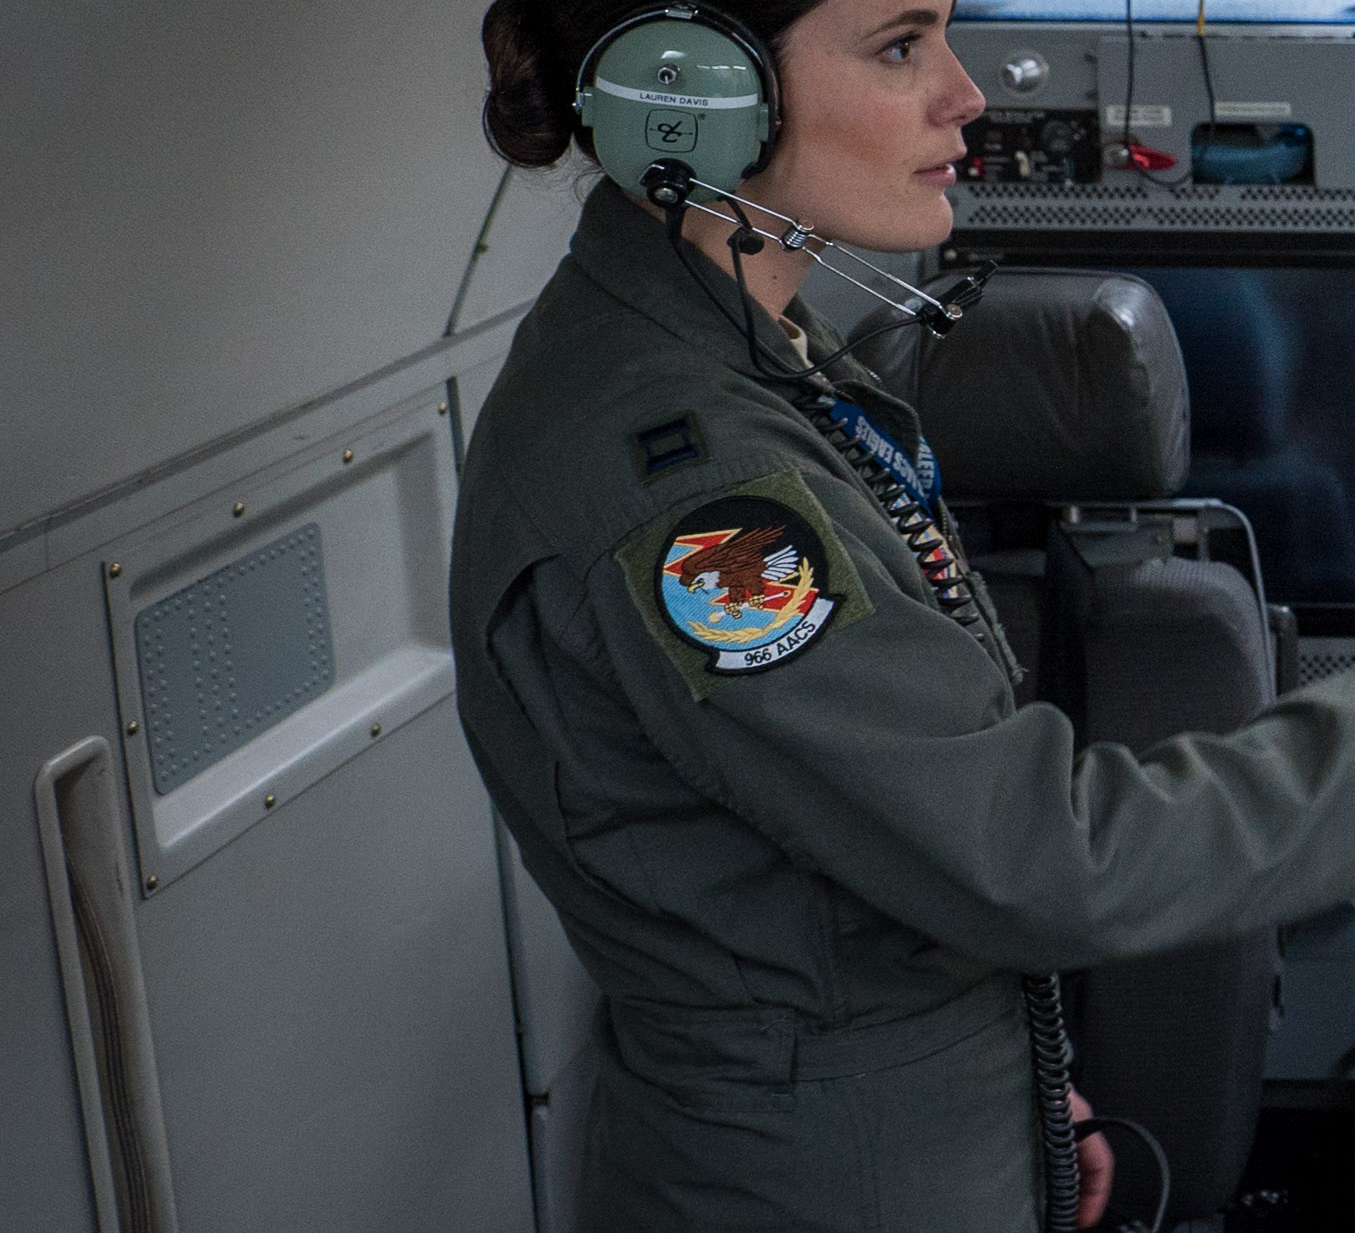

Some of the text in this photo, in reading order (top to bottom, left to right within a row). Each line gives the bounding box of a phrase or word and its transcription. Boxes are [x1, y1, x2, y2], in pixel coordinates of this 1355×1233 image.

[640, 92, 709, 107] LAUREN DAVIS
[744, 620, 816, 667] 966 AACS
